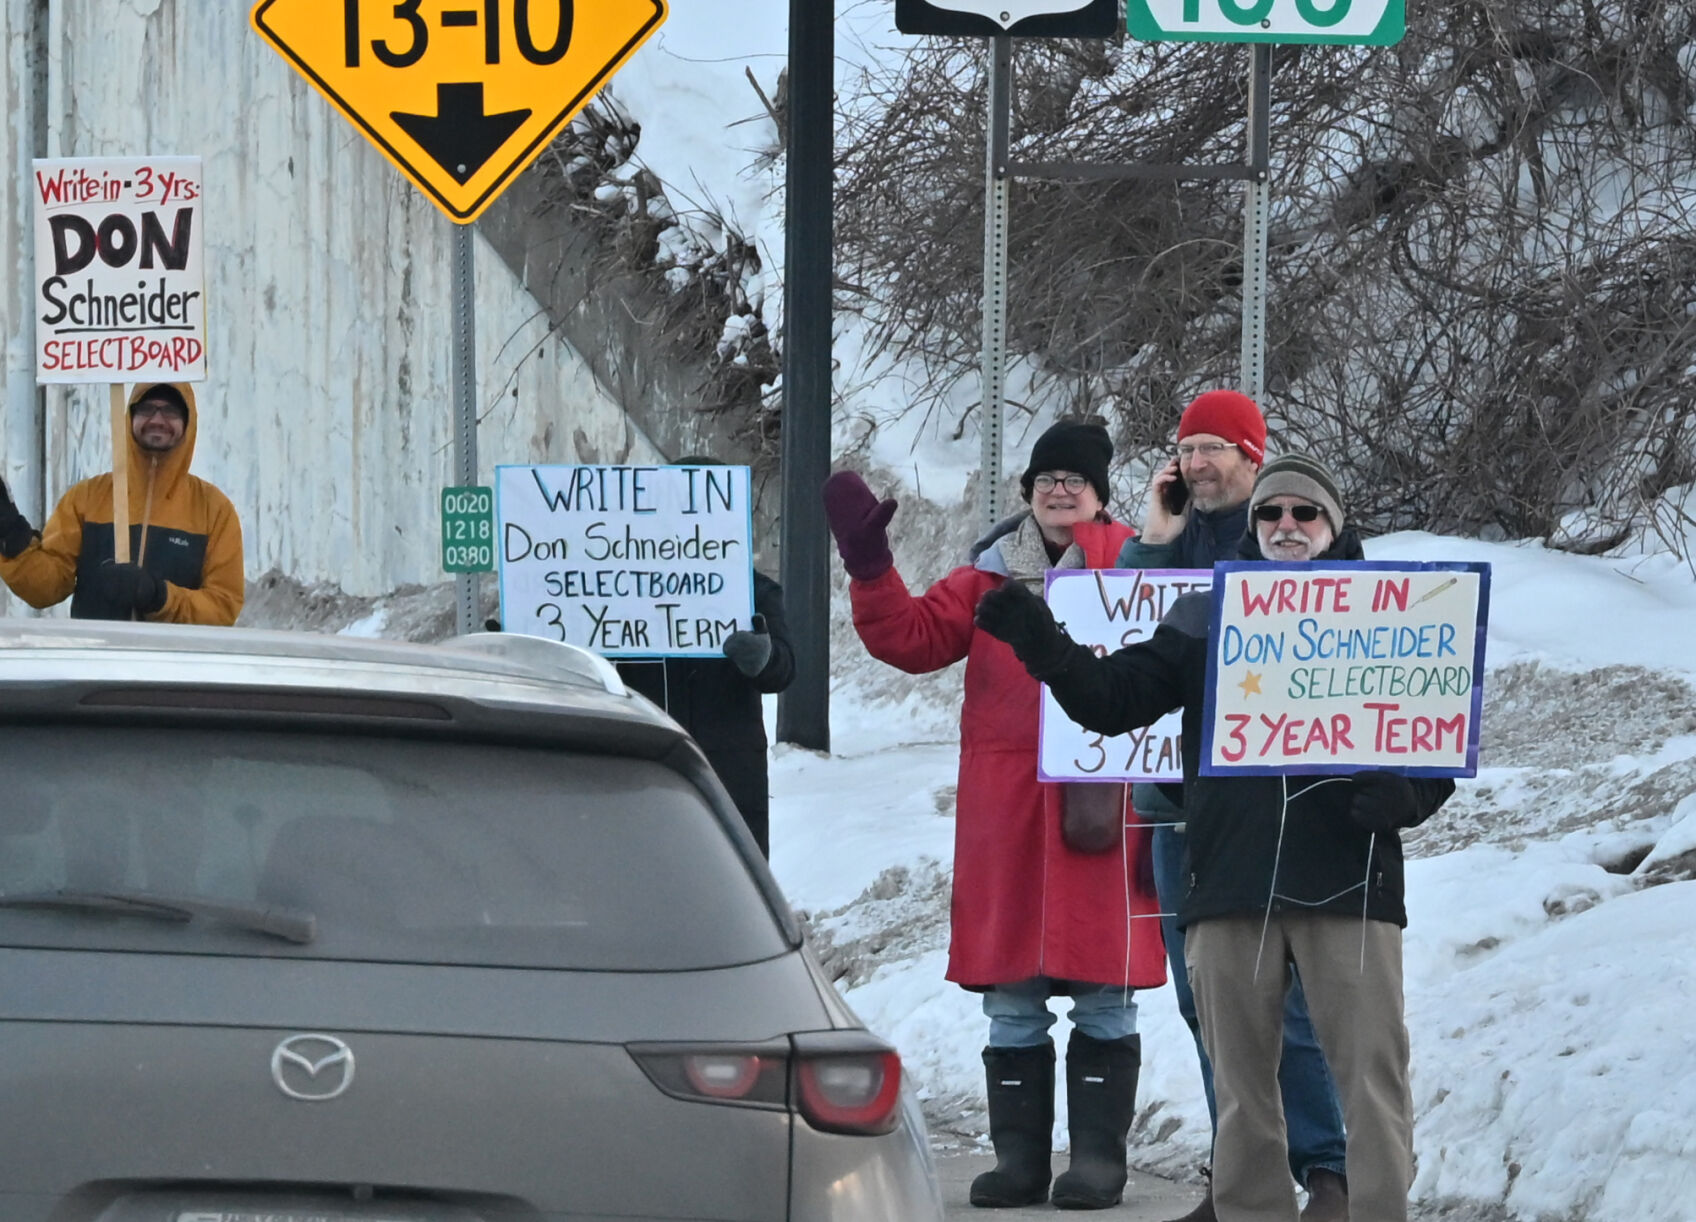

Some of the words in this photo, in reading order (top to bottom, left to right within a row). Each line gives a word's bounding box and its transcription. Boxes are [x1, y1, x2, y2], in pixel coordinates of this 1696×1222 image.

[48, 207, 193, 276] DON
[41, 276, 200, 326] Schneider
[42, 336, 202, 372] SELECTBOARD
[445, 494, 489, 514] 0020
[531, 467, 658, 515] WRITE
[681, 468, 733, 515] IN
[446, 520, 490, 540] 1218
[505, 523, 567, 562] Don
[585, 522, 740, 560] Schneider
[446, 546, 490, 566] 0380
[544, 570, 724, 598] SELECTBOARD
[1094, 570, 1211, 622] WRIT
[1241, 577, 1352, 617] WRITE
[1371, 577, 1410, 613] IN
[536, 602, 566, 643] 3
[582, 603, 650, 649] YEAR
[655, 603, 737, 649] TERM
[1223, 624, 1285, 666] DON
[1293, 618, 1456, 662] SCHNEIDER
[1287, 665, 1471, 699] SELECTBOARD
[1074, 727, 1106, 773] 3
[1220, 714, 1252, 762] 3
[1258, 712, 1355, 757] YEAR
[1362, 702, 1466, 754] TERM
